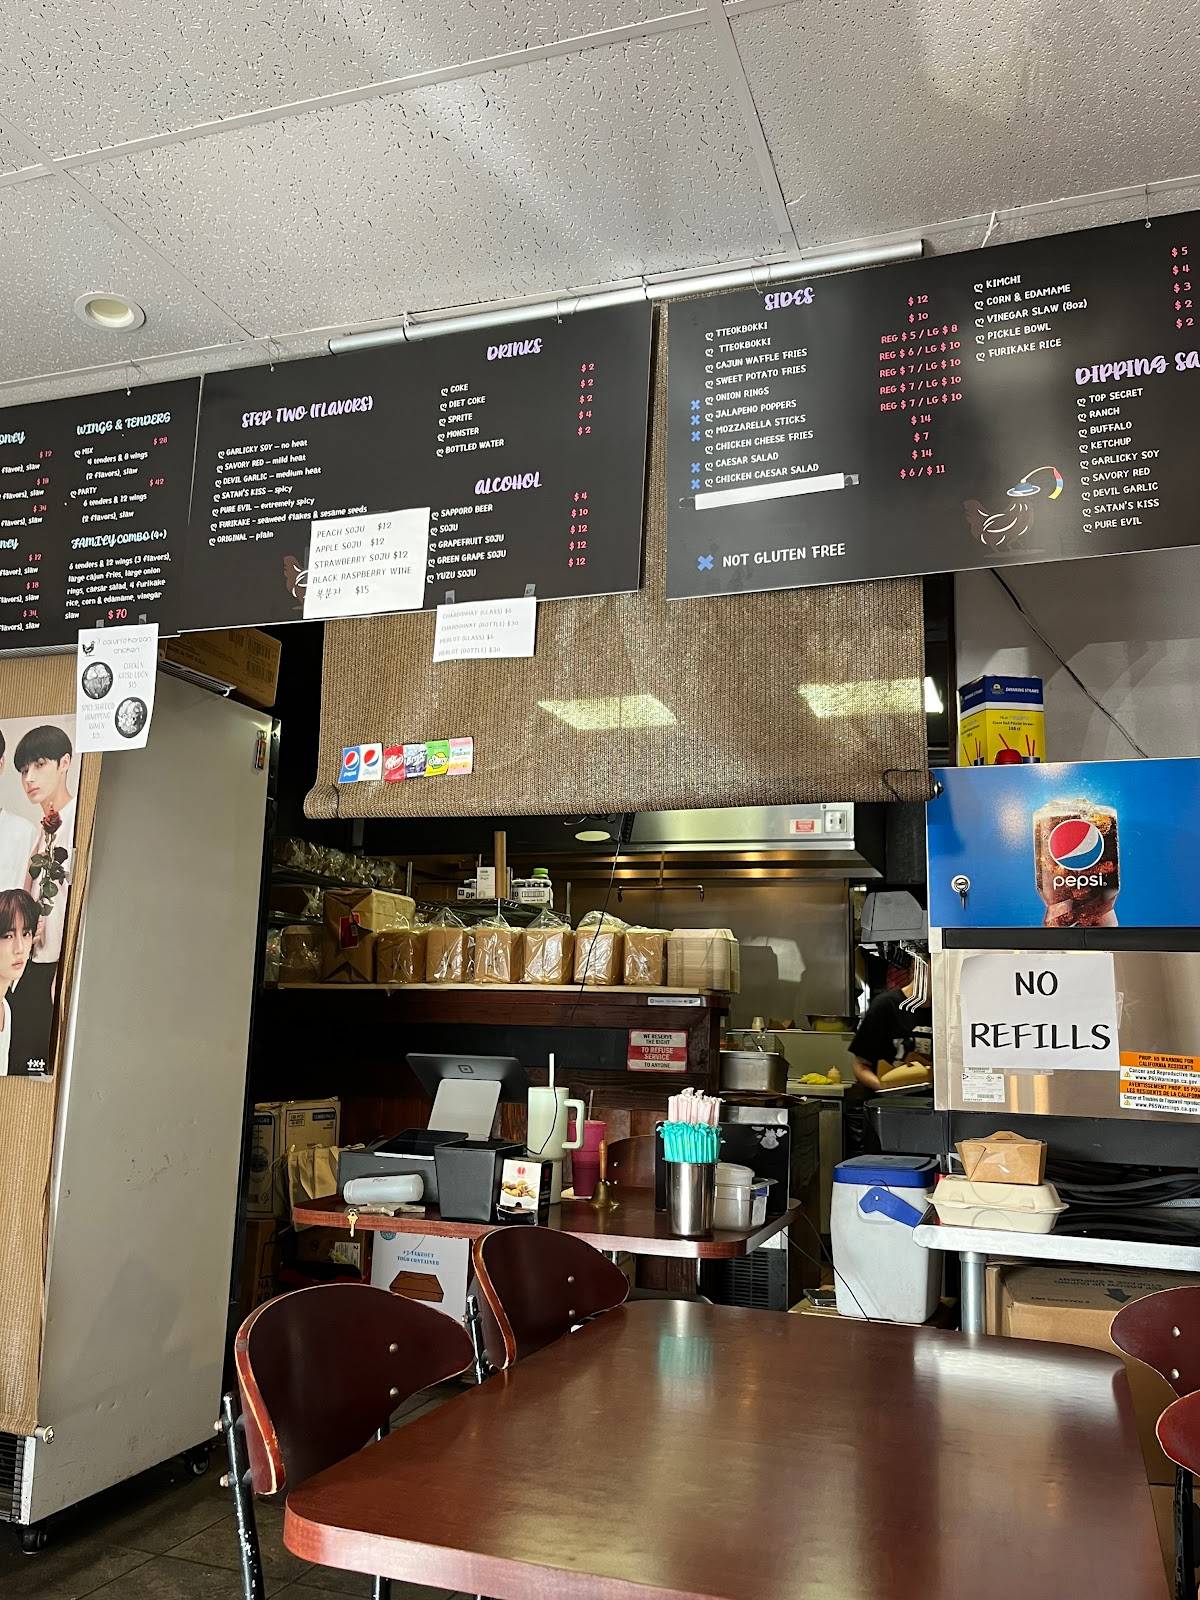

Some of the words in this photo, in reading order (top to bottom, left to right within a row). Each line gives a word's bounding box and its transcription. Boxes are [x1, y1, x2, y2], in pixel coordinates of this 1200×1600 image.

[986, 275, 1020, 288] KIMCHI
[765, 287, 815, 310] SIDES
[987, 294, 1011, 305] CORN
[1025, 284, 1070, 299] EDAMAME
[987, 309, 1028, 323] VINEGAR
[1032, 304, 1059, 316] SLAW
[1063, 299, 1087, 311] (8oz)
[716, 322, 767, 337] TTEOKBOKKI
[881, 335, 898, 344] REG
[927, 328, 939, 336] LG
[988, 327, 1021, 340] PICKLE
[1024, 323, 1051, 334] BOWL
[487, 338, 543, 360] DRINKS
[719, 338, 770, 352] TTEOKBOKKI
[988, 343, 1035, 357] FURIKAKE
[1039, 338, 1061, 349] RICE
[716, 358, 743, 369] CAJUN
[745, 353, 779, 365] WAFFLE
[782, 348, 807, 359] FRIES
[716, 374, 743, 385] SWEET
[746, 369, 778, 381] POTATO
[781, 365, 806, 375] FRIES
[450, 384, 468, 393] COKE
[716, 391, 741, 401] ONION
[744, 387, 769, 397] RINGS
[1089, 394, 1106, 403] TOP
[1109, 388, 1143, 400] SECRET
[449, 399, 465, 408] DIET
[467, 396, 485, 405] COKE
[716, 405, 758, 418] JALAPENO
[761, 400, 796, 412] POPPERS
[242, 410, 272, 428] STEP
[277, 406, 308, 422] TWO
[448, 413, 472, 423] SPRITE
[1089, 407, 1119, 418] RANCH
[77, 421, 113, 435] WINGS
[125, 412, 170, 428] TENDERS
[716, 420, 772, 434] MOZZARELLA
[775, 415, 806, 426] STICKS
[1090, 421, 1132, 434] BUFFALO
[447, 427, 479, 438] MONSTER
[716, 439, 751, 450] CHICKEN
[754, 434, 785, 445] CHEESE
[788, 430, 813, 441] FRIES
[226, 446, 258, 456] GARLICKY
[260, 444, 273, 452] SOY
[445, 443, 477, 454] BOTTLED
[479, 439, 504, 449] WATER
[1091, 437, 1131, 450] KETCHUP
[225, 461, 250, 470] SAVORY
[252, 459, 264, 467] RED
[272, 455, 288, 464] mild
[290, 454, 306, 462] heat
[716, 456, 748, 467] CAESAR
[751, 452, 779, 463] SALAD
[1092, 453, 1138, 465] GARLICKY
[1141, 450, 1159, 459] SOY
[223, 476, 241, 485] DEVIL
[243, 473, 267, 482] GARLIC
[276, 470, 303, 478] medium
[305, 467, 321, 475] heat
[716, 472, 752, 483] CHICKEN
[754, 467, 788, 478] CAESAR
[791, 464, 819, 474] SALAD
[1093, 470, 1129, 481] SAVORY
[1133, 467, 1150, 476] RED
[78, 487, 97, 495] PARTY
[222, 488, 249, 499] SATAN'S
[251, 487, 266, 496] KISS
[275, 485, 292, 494] spicy
[1093, 487, 1120, 497] DEVIL
[1123, 482, 1158, 493] GARLIC
[220, 505, 236, 514] PURE
[237, 504, 252, 512] EVIL
[261, 499, 295, 509] extremely
[296, 497, 315, 506] spicy
[441, 506, 473, 517] SAPPORO
[475, 504, 493, 513] BEER
[1094, 501, 1133, 513] SATAN'S
[1137, 499, 1159, 508] KISS
[219, 518, 250, 528] FURIKAKE
[257, 514, 286, 524] seaweed
[320, 509, 346, 517] sesame
[348, 505, 367, 514] seeds
[1095, 519, 1117, 529] PURE
[1121, 517, 1142, 526] EVIL
[317, 529, 342, 538] PEACH
[345, 526, 365, 535] SOJU
[378, 522, 391, 531] $12
[440, 524, 458, 533] SOJU
[71, 534, 116, 549] FAMILY
[117, 531, 150, 544] COMBO
[217, 533, 247, 543] ORIGINAL
[256, 531, 273, 541] plain
[438, 537, 483, 548] GRAPEFRUIT
[485, 534, 504, 543] SOJU
[316, 544, 338, 552] APPLE
[342, 540, 361, 550] SOJU
[371, 538, 384, 547] $12
[314, 555, 366, 568] STRAWBERRY
[370, 553, 390, 561] SOJU
[393, 551, 408, 560] $12
[437, 555, 460, 564] GREEN
[461, 552, 485, 561] GRAPE
[487, 550, 506, 559] SOJU
[723, 554, 749, 567] NOT
[754, 547, 806, 564] GLUTEN
[811, 543, 845, 558] FREE
[313, 575, 336, 584] BLACK
[341, 568, 387, 580] RASPBERRY
[436, 571, 455, 580] YUZU
[457, 569, 476, 578] SOJU
[356, 585, 369, 595] $15
[1053, 872, 1103, 890] pepsi
[1016, 971, 1058, 996] NO
[971, 1023, 1110, 1050] REFILLS
